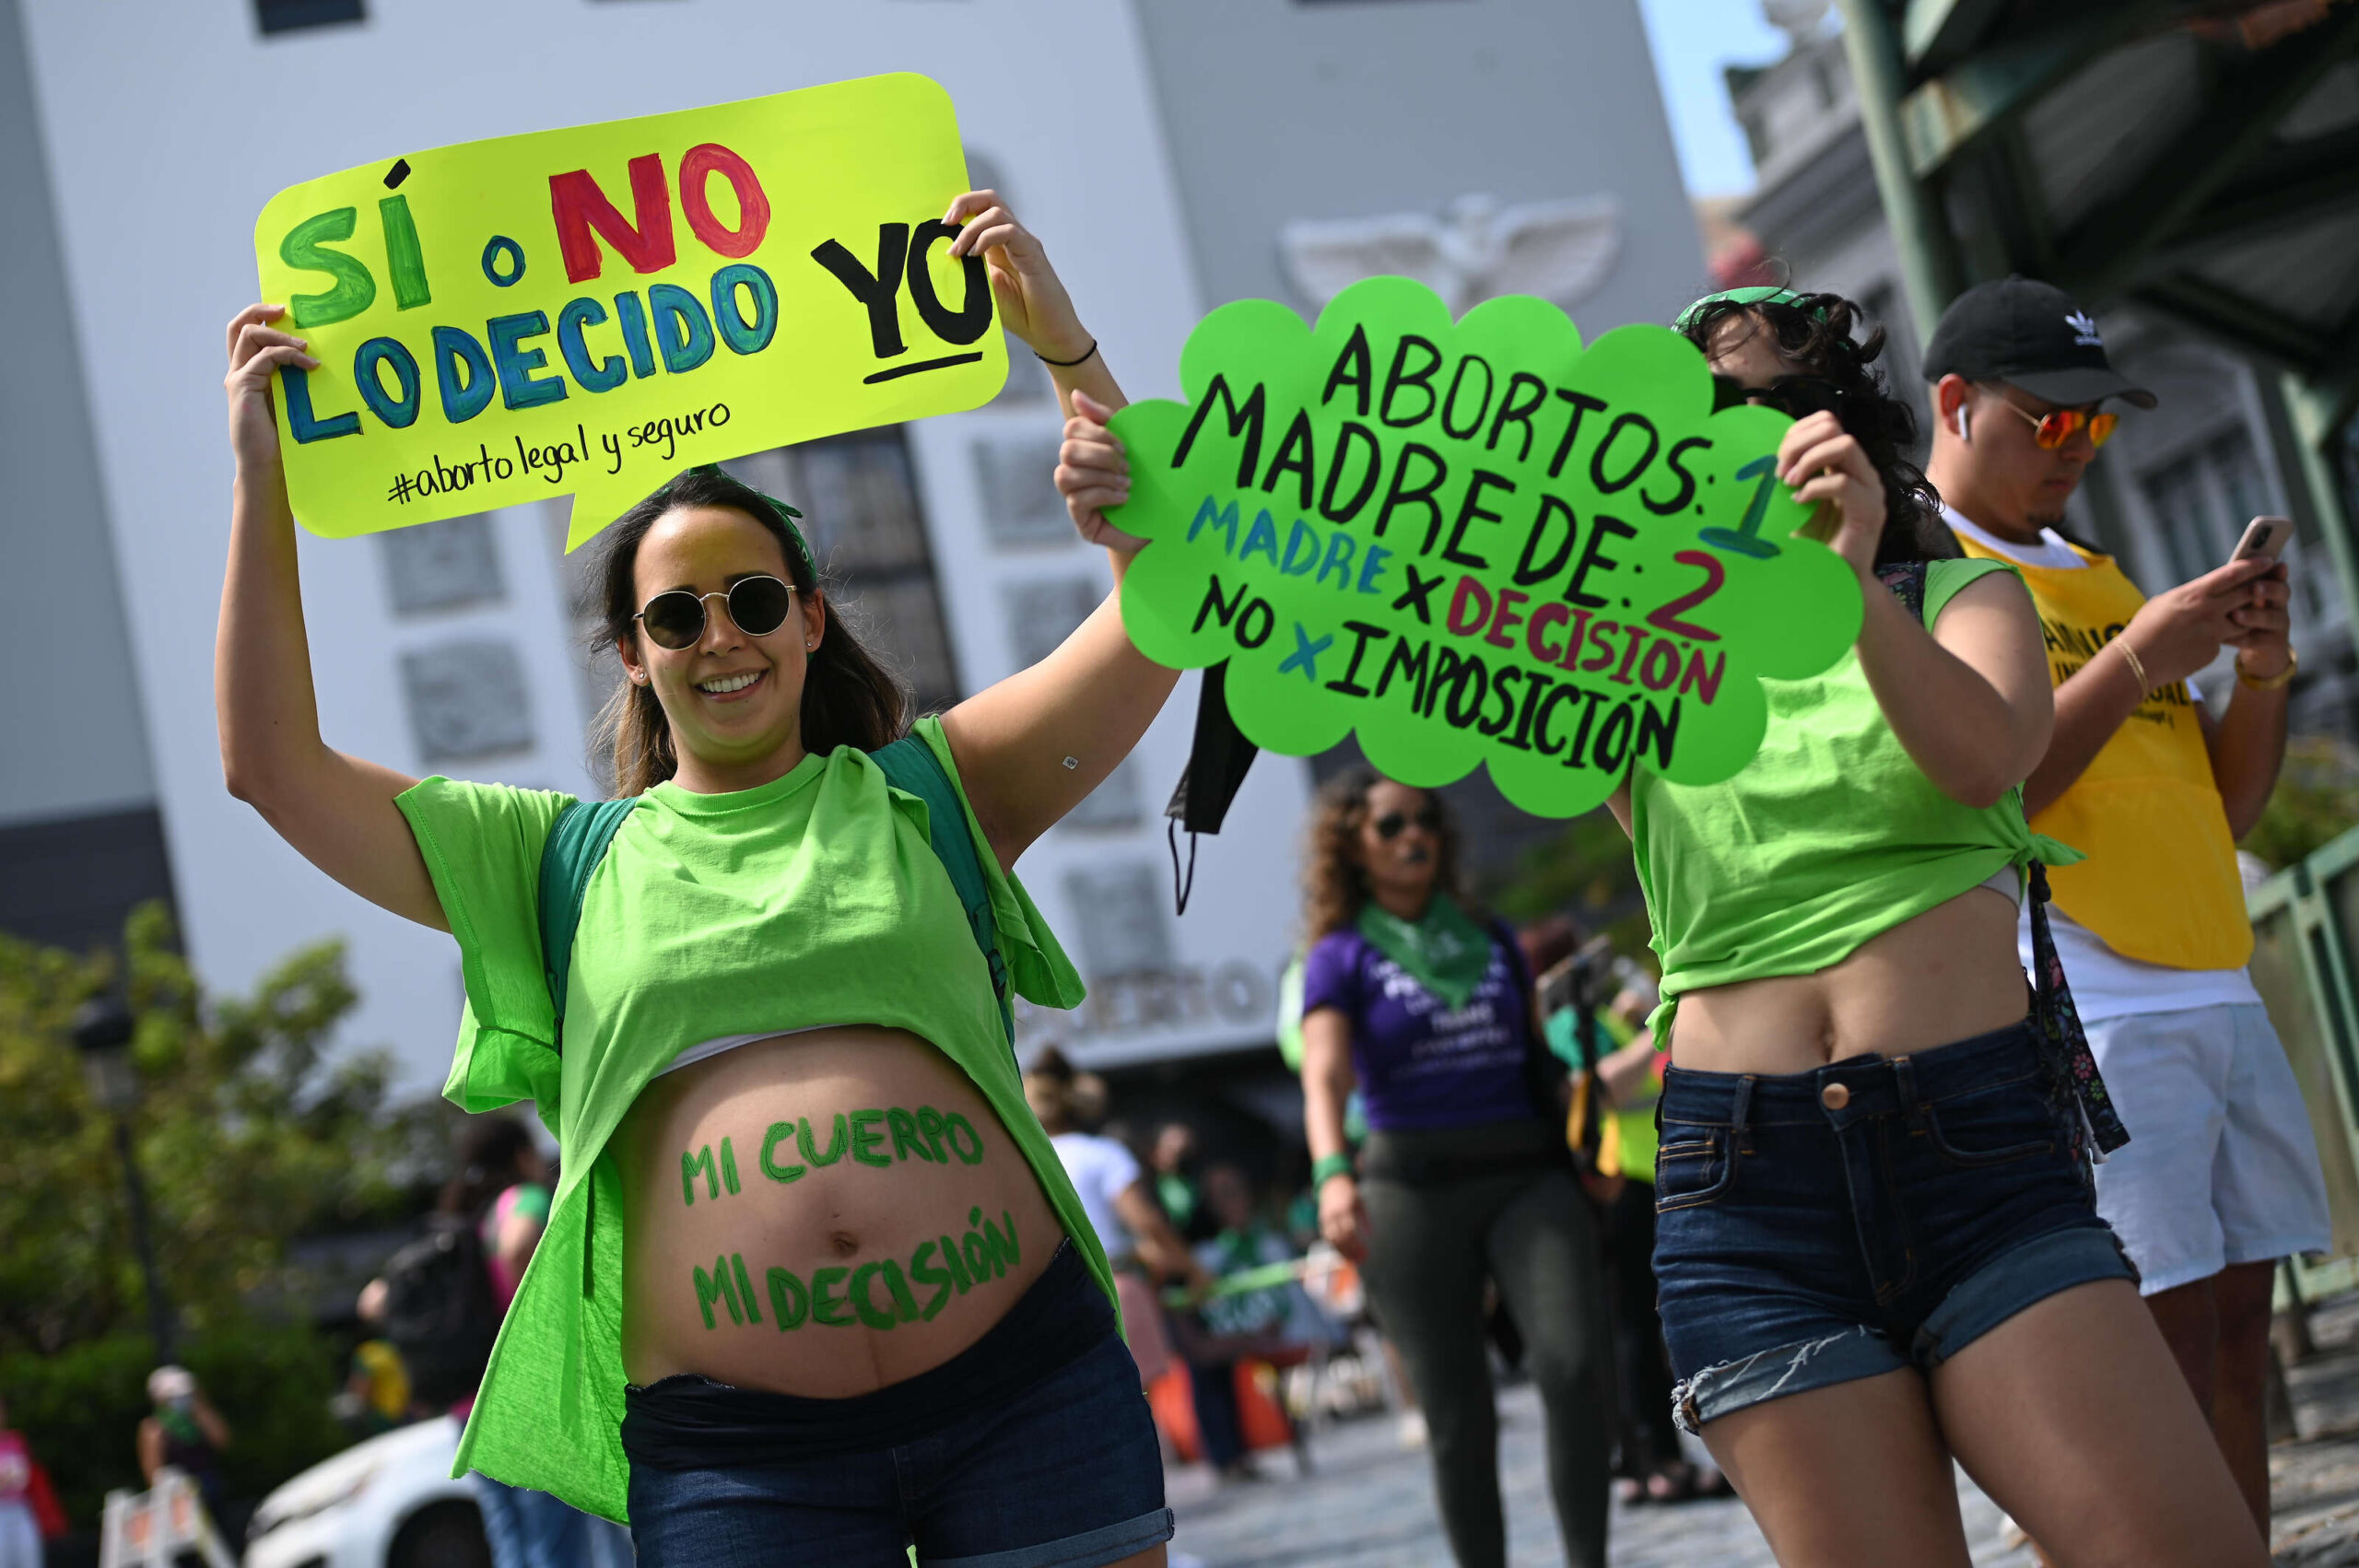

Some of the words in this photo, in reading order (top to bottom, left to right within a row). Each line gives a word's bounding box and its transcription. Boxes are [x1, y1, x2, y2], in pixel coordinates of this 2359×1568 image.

[279, 158, 431, 329] SÍ
[548, 143, 770, 285] NO
[810, 218, 992, 358] YO
[602, 433, 622, 474] y
[628, 403, 731, 461] seguro
[1170, 373, 1517, 570] MADRE
[1512, 494, 1643, 609] DE:
[1645, 549, 1726, 642] 2
[1322, 323, 1715, 516] ABORTOS:
[1698, 454, 1782, 560] 1
[1186, 494, 1394, 594] MADRE
[1446, 575, 1726, 706] DECISIÓN
[1191, 574, 1275, 649] NO
[1324, 620, 1682, 774] IMPOSICIÓN
[681, 1136, 741, 1206] MI
[759, 1106, 984, 1183] CUERPO
[693, 1252, 762, 1329] MI
[766, 1205, 1020, 1332] DECISIÓN
